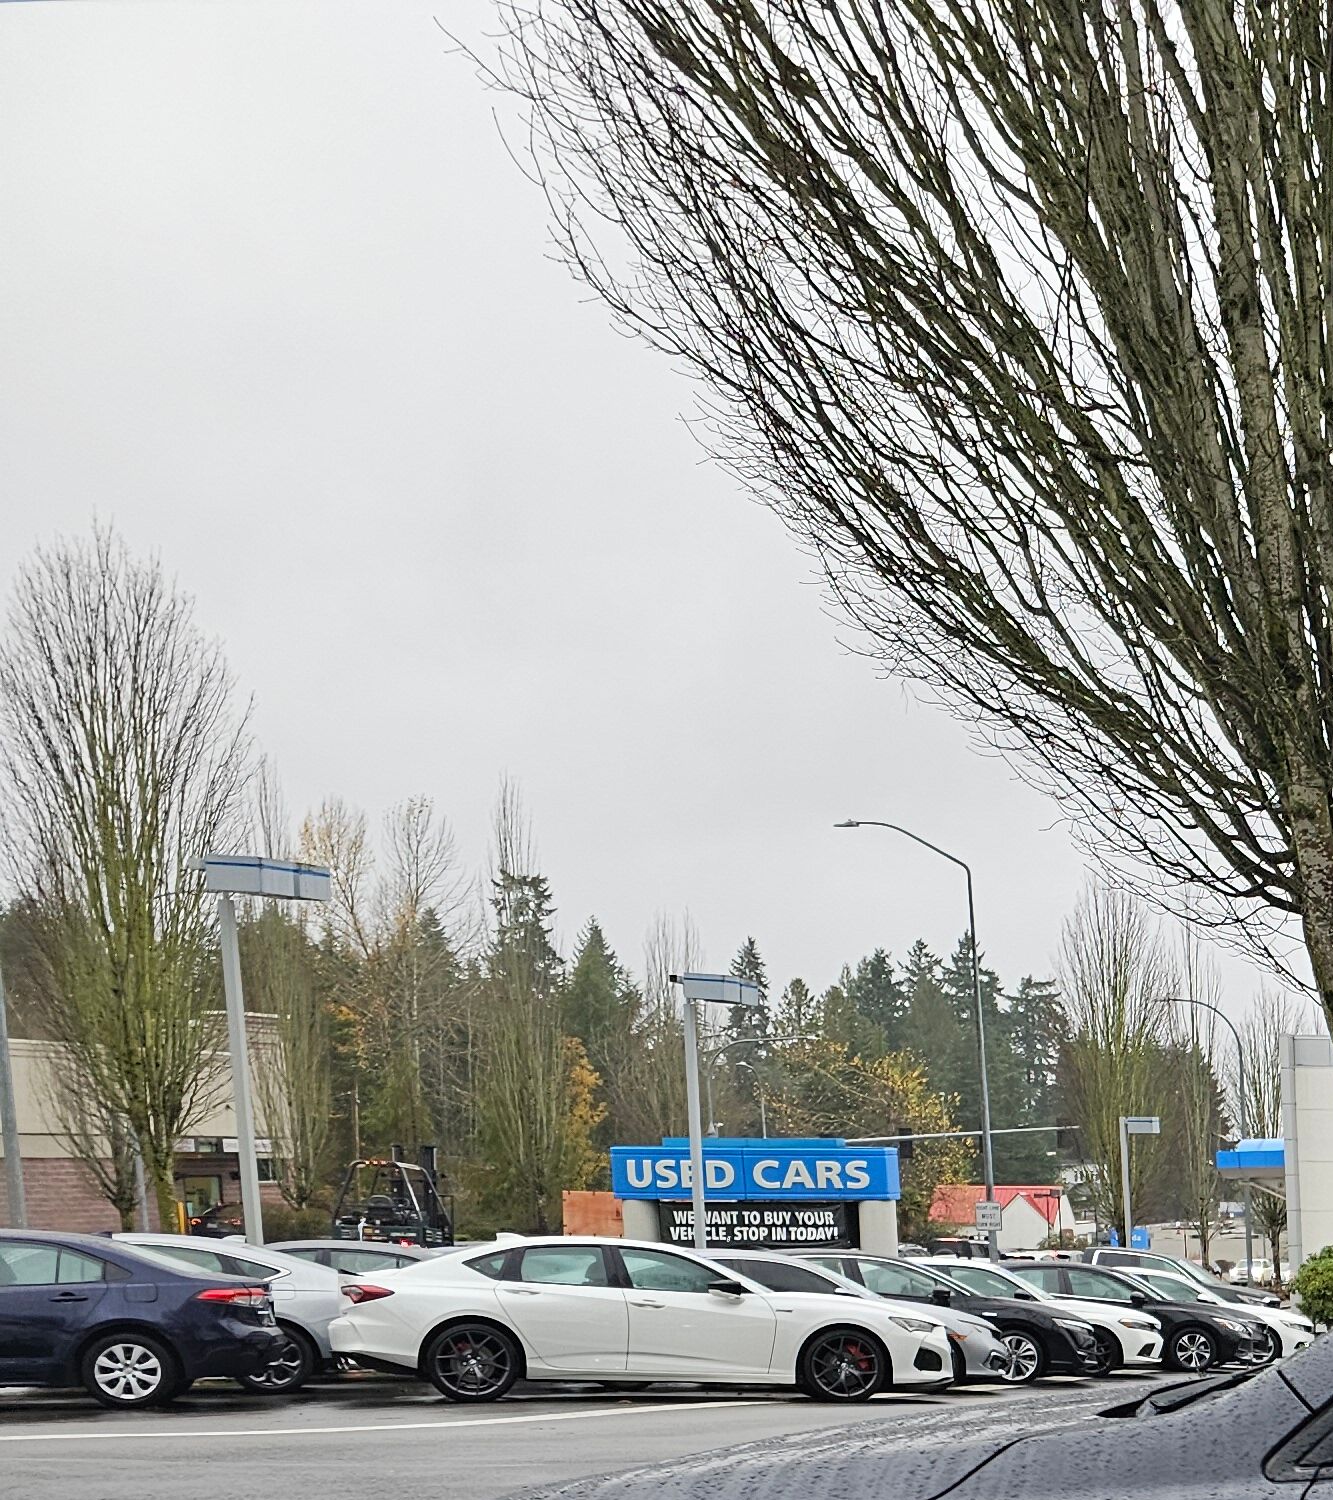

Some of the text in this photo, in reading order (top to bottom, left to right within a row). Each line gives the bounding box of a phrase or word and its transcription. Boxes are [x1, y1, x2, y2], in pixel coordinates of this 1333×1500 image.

[626, 1159, 870, 1189] USED CARS
[673, 1210, 695, 1225] WE
[742, 1211, 760, 1225] TO
[764, 1211, 793, 1225] BUY
[794, 1211, 834, 1225] YOUR
[670, 1226, 839, 1243] VEHCLE, STOP IN TODAY!
